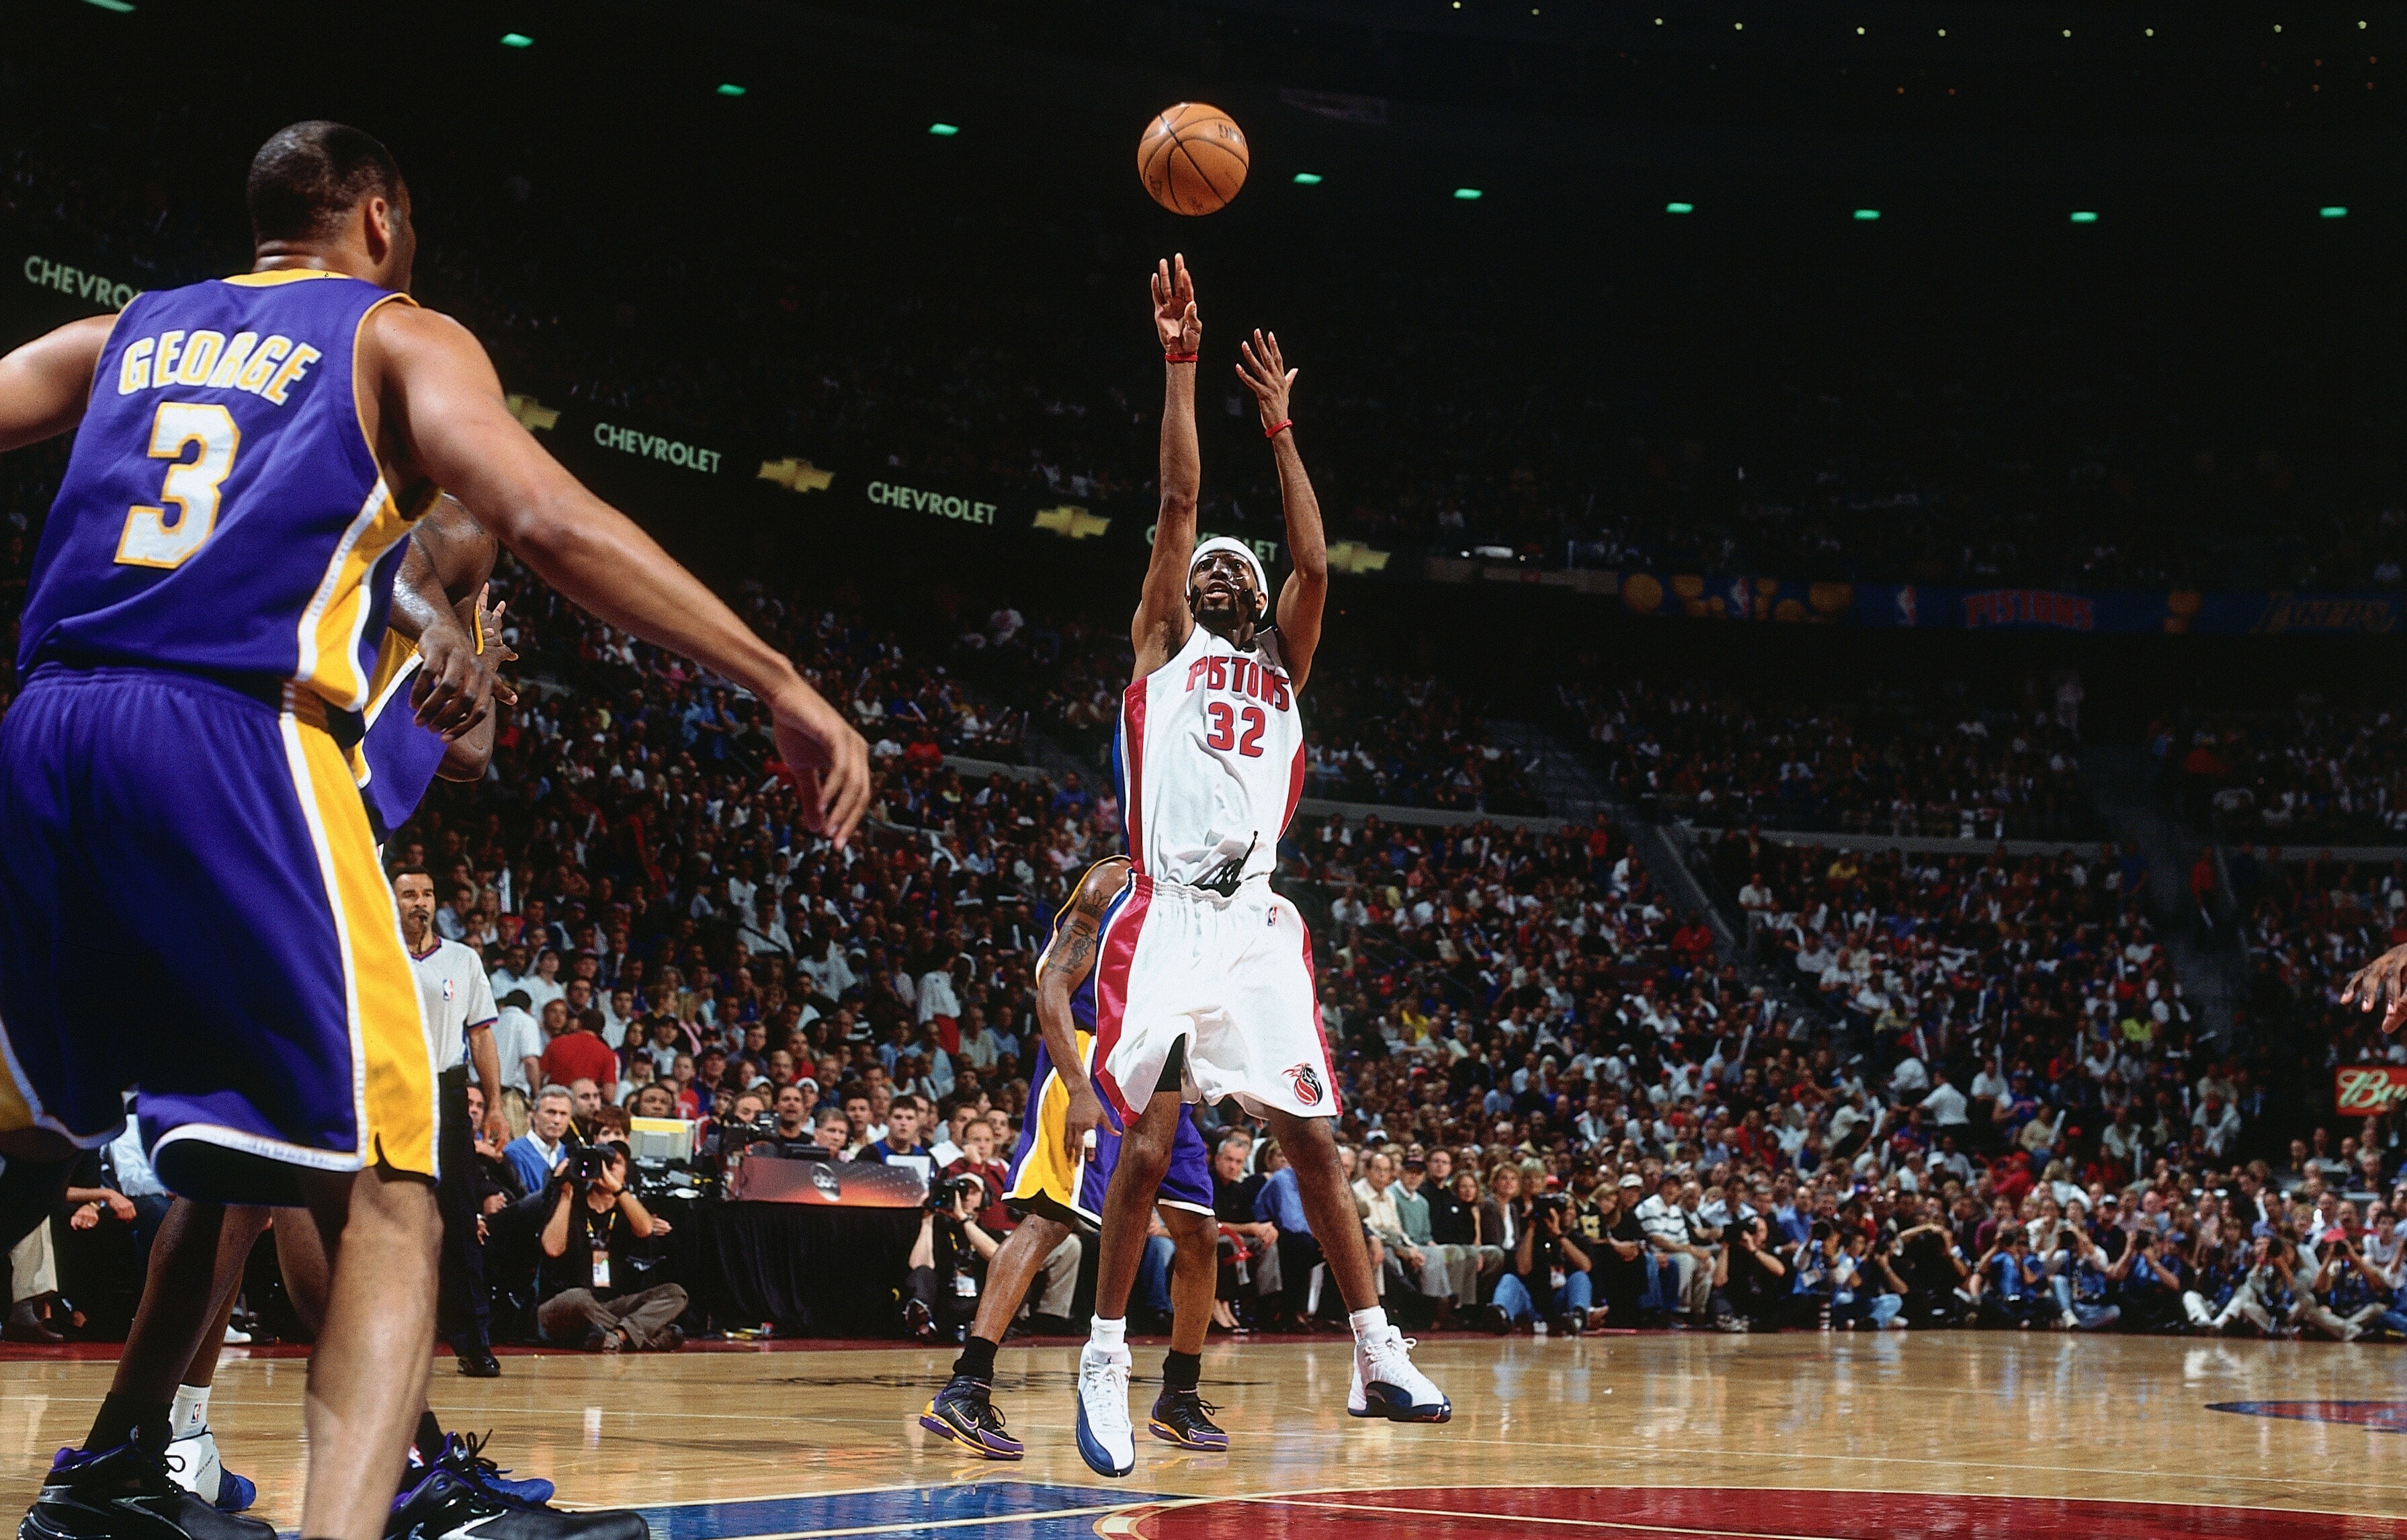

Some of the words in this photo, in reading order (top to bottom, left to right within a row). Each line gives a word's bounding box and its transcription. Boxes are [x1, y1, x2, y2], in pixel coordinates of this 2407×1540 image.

[24, 255, 142, 310] CHEVRO
[118, 330, 322, 406] GEORGE
[594, 423, 721, 474] CHEVROLET
[114, 401, 241, 569] 3
[868, 481, 997, 525] CHEVROLET
[1963, 589, 2094, 630] PISTONS
[1185, 655, 1290, 712] PISTONS
[1207, 701, 1265, 758] 32
